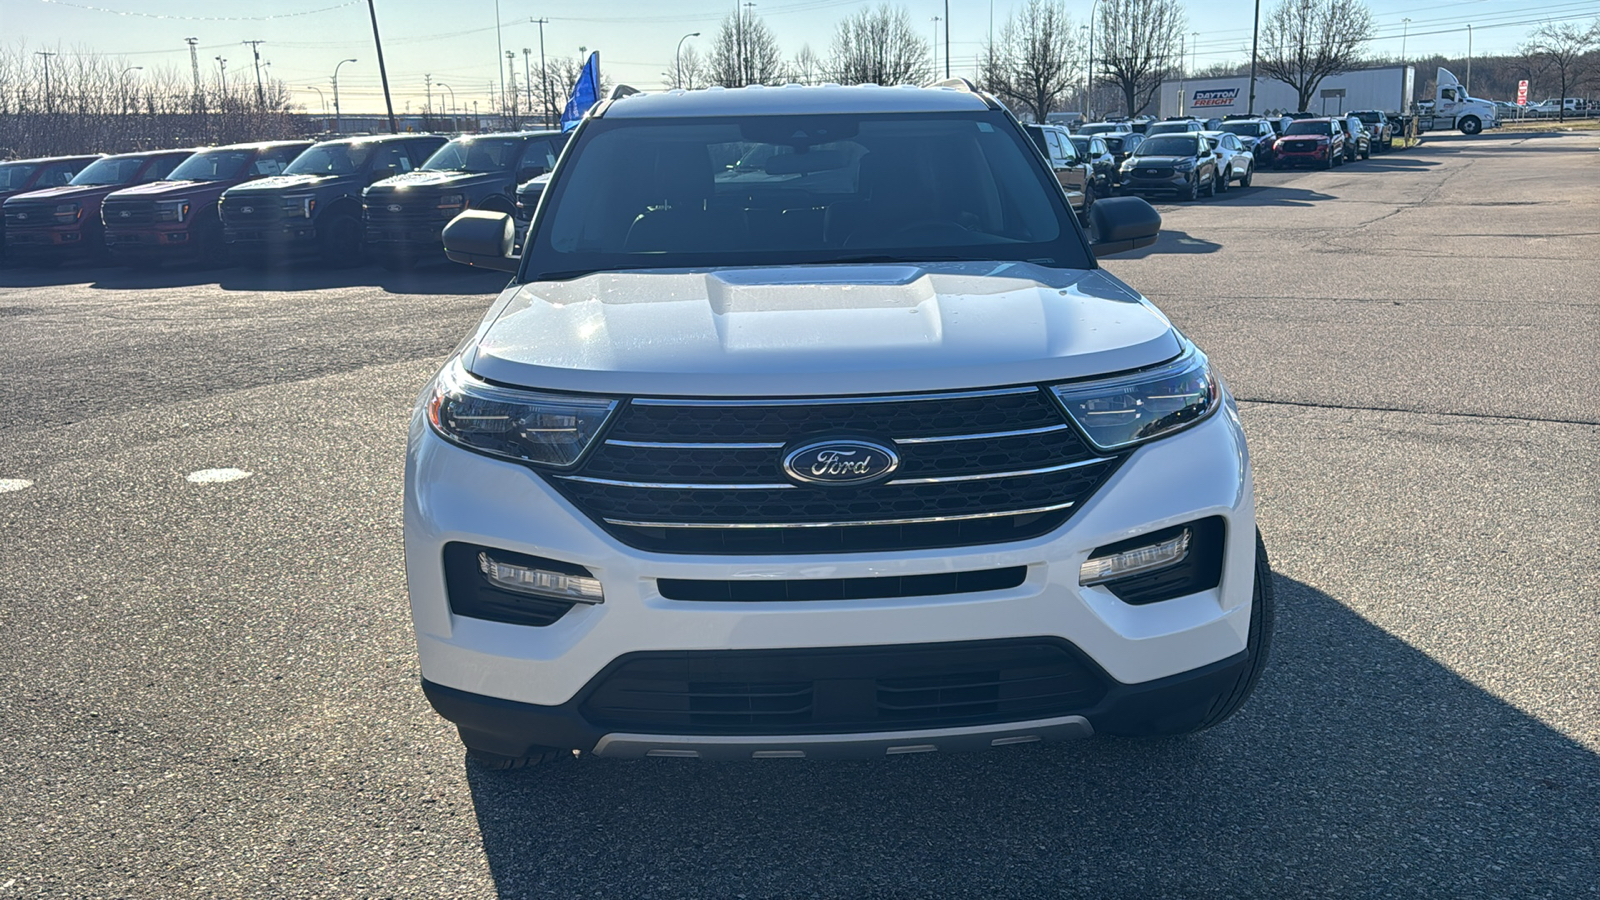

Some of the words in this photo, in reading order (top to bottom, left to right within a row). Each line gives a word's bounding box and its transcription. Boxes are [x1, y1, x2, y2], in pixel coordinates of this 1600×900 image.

[1196, 91, 1236, 99] DAYTON
[1194, 98, 1234, 106] FREIGHT
[811, 450, 871, 475] Ford
